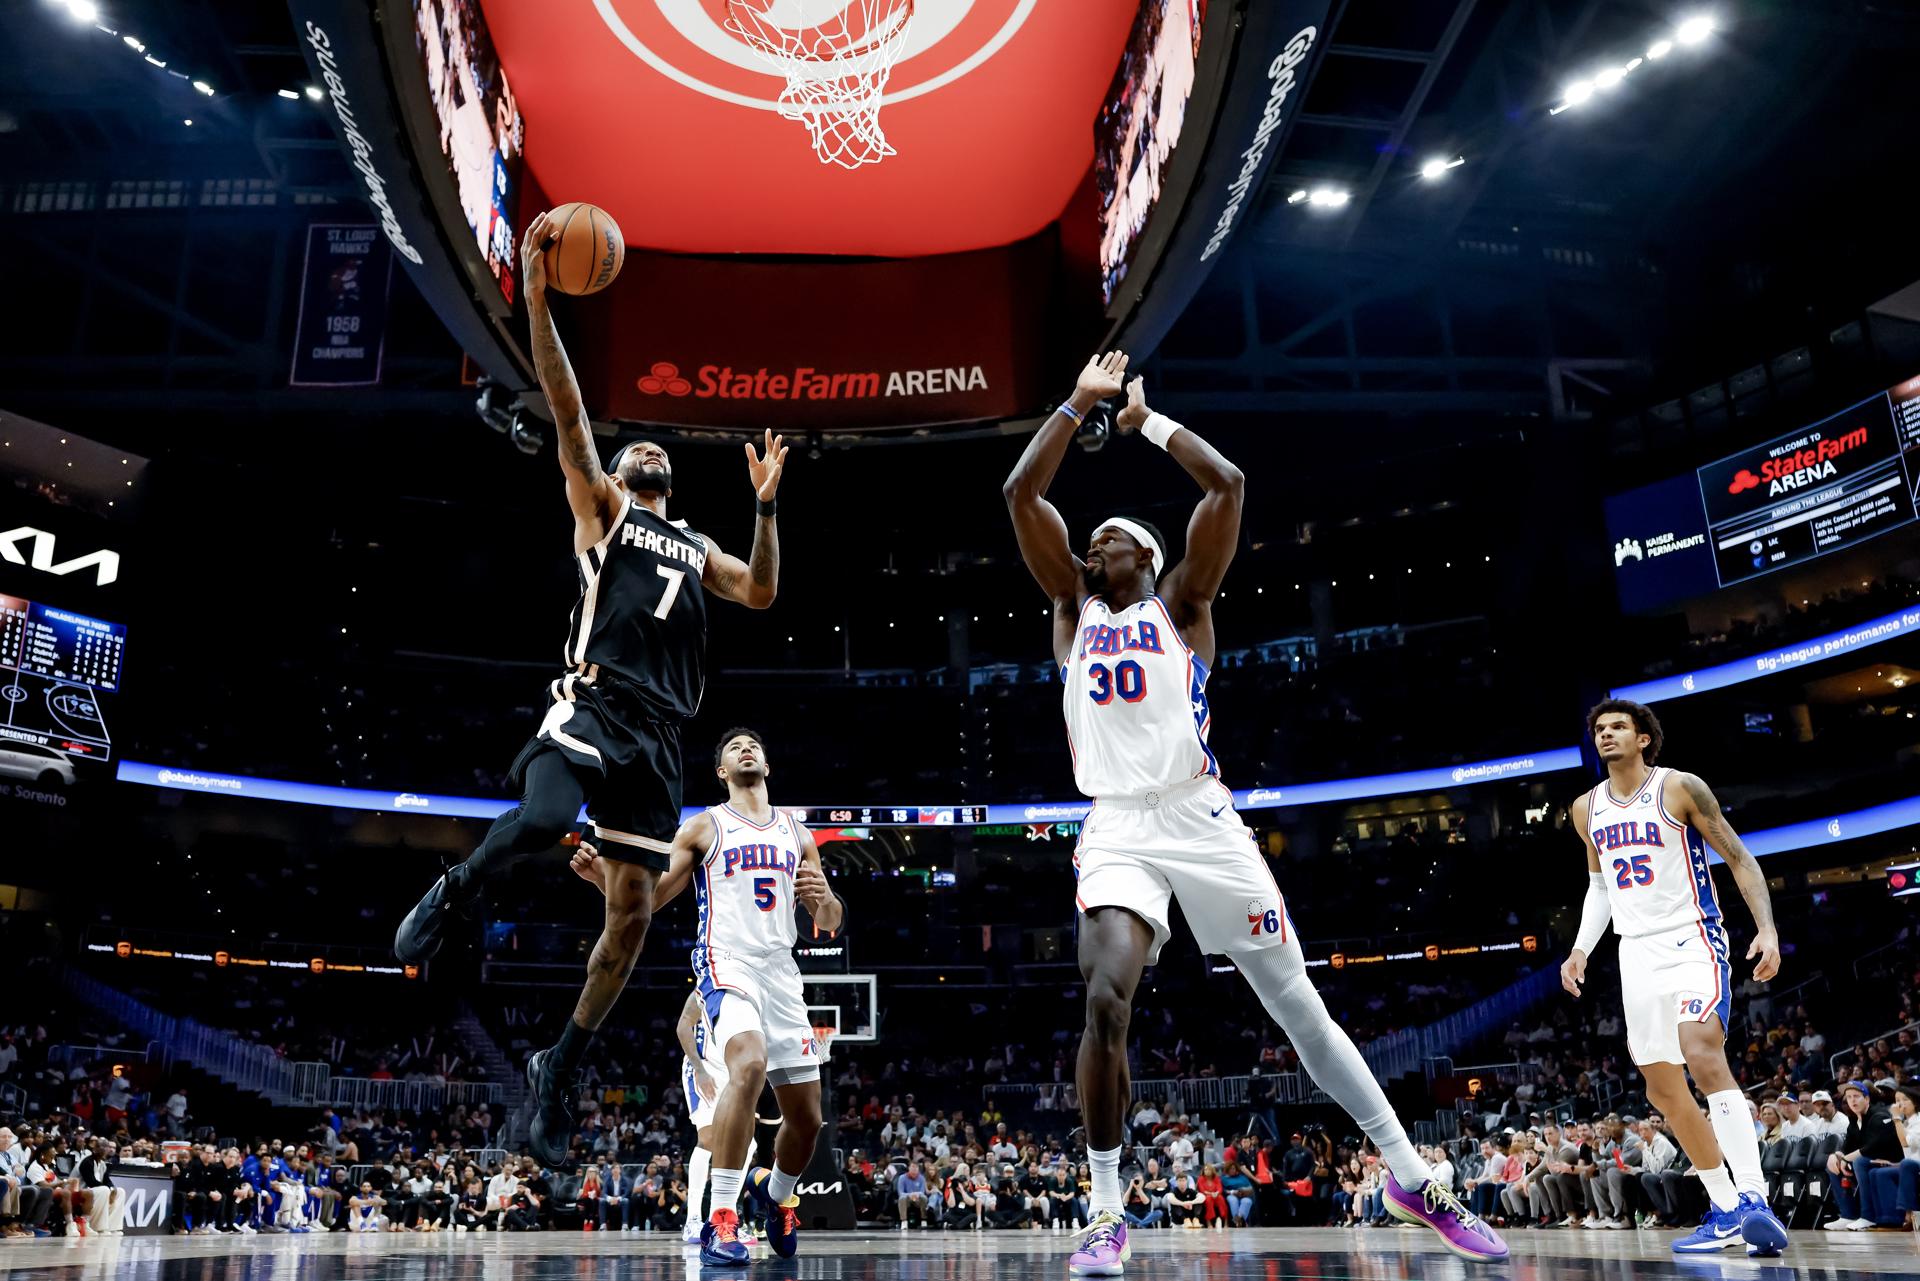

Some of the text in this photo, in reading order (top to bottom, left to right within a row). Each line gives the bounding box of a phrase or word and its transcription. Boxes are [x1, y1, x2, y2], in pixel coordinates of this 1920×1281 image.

[327, 230, 377, 242] ST. LOUIS
[330, 243, 370, 254] HAWKS
[326, 316, 360, 332] 1958
[884, 366, 988, 397] ARENA
[1769, 432, 1821, 458] WELCOME TO
[1769, 460, 1837, 496] ARENA
[1772, 487, 1843, 518] AROUND THE LEAGUE
[1815, 518, 1832, 530] Cedric
[1875, 496, 1890, 507] ranks
[1862, 512, 1876, 524] game
[1877, 503, 1896, 516] among
[1645, 532, 1674, 548] KAISER
[1647, 534, 1705, 558] PERMANENTE
[1768, 537, 1779, 547] LAC
[1771, 551, 1786, 562] MEM
[654, 564, 686, 620] 7
[1080, 620, 1164, 661] PHILA
[1756, 612, 1920, 671] Big-league performance for
[1088, 660, 1147, 705] 30
[38, 736, 48, 745] BY
[158, 770, 241, 789] globalpayments
[1452, 758, 1534, 782] globalpayments
[14, 785, 67, 806] Sorento
[394, 794, 429, 808] genius
[1247, 790, 1281, 804] genius
[830, 810, 852, 822] 6:50
[892, 810, 908, 822] 13
[1592, 821, 1664, 856] PHILA
[723, 844, 796, 880] PHILA
[1613, 854, 1654, 889] 25
[754, 878, 776, 912] 5
[1248, 910, 1279, 936] 76
[809, 947, 843, 956] TISSOT
[1680, 999, 1702, 1014] 76
[797, 1181, 842, 1194] KIA
